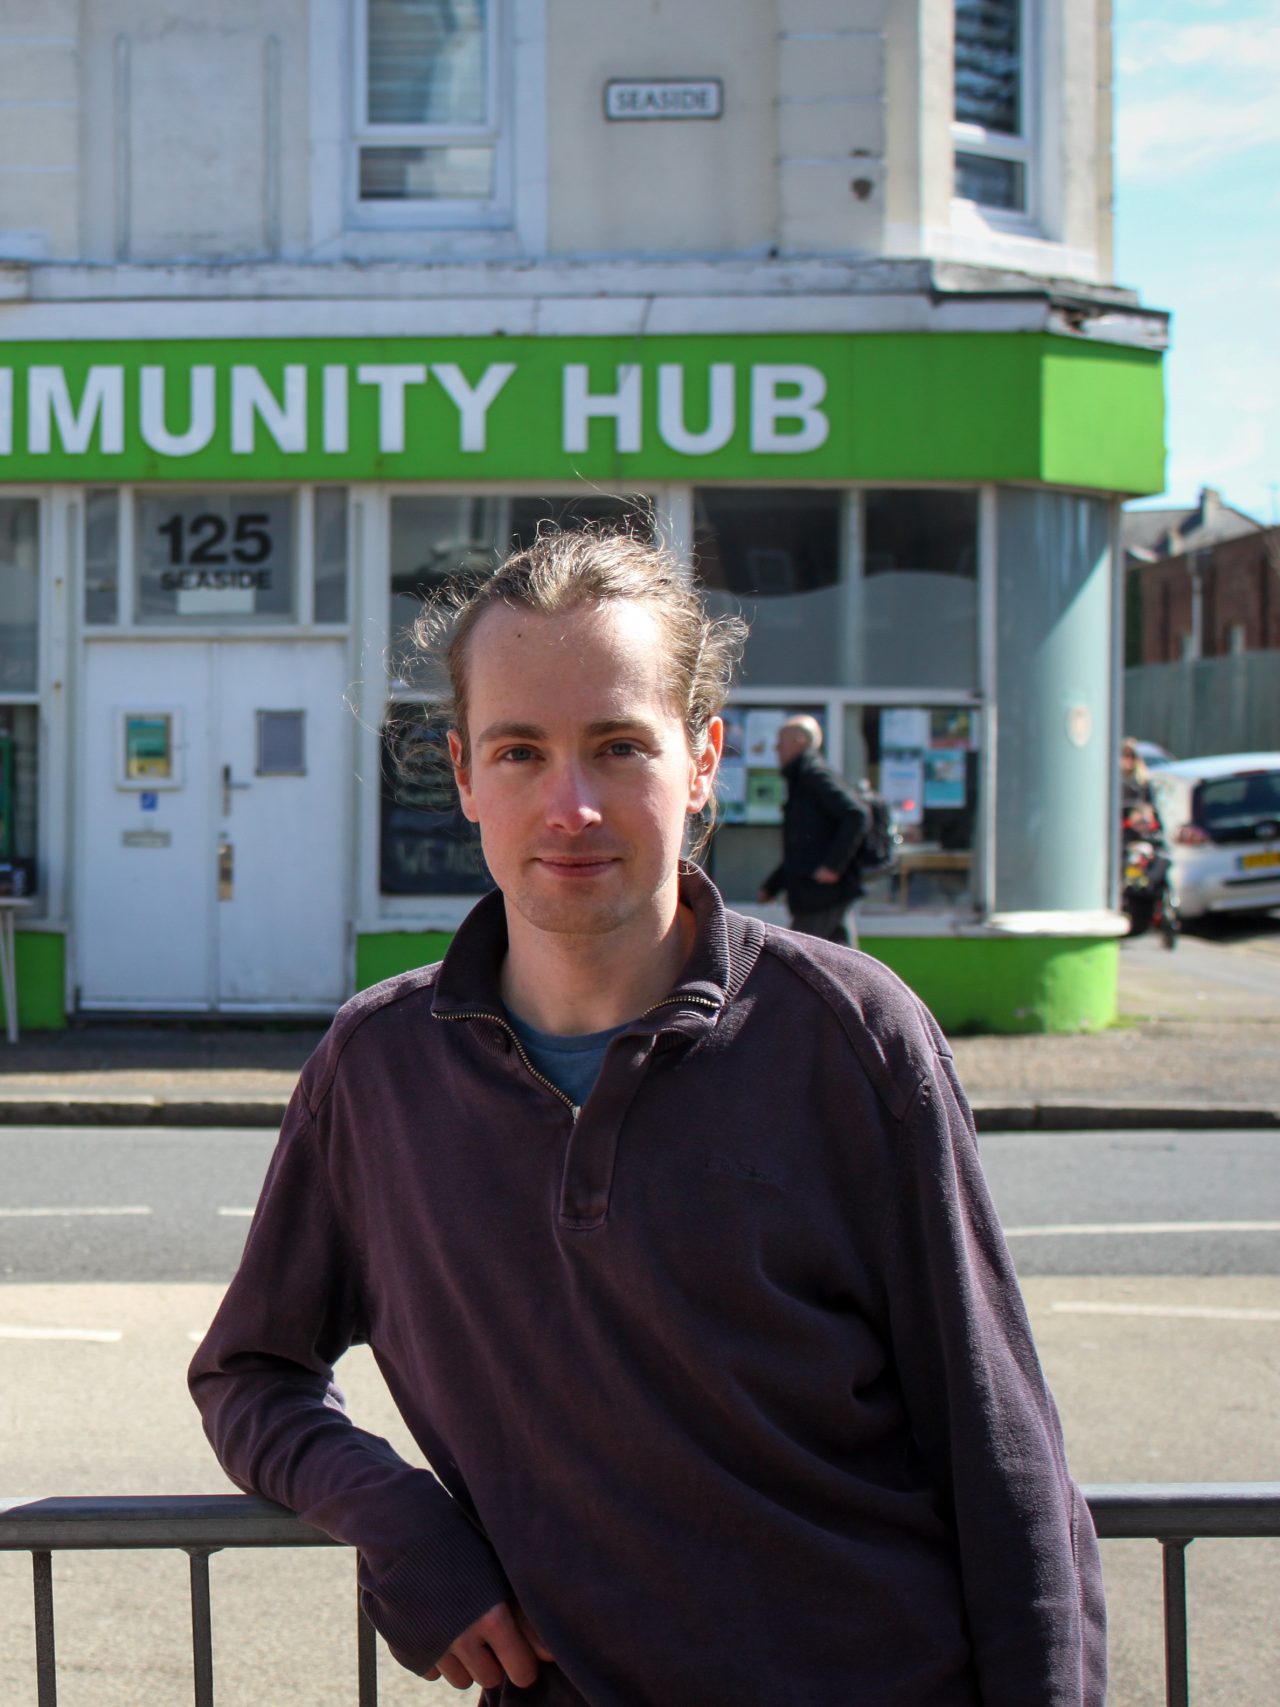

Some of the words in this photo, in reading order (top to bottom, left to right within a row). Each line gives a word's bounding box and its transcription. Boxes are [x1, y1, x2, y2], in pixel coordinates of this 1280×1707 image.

[616, 89, 711, 111] SEASIDE
[562, 363, 830, 456] HUB
[158, 514, 273, 565] 125
[161, 569, 273, 591] SEASIDE
